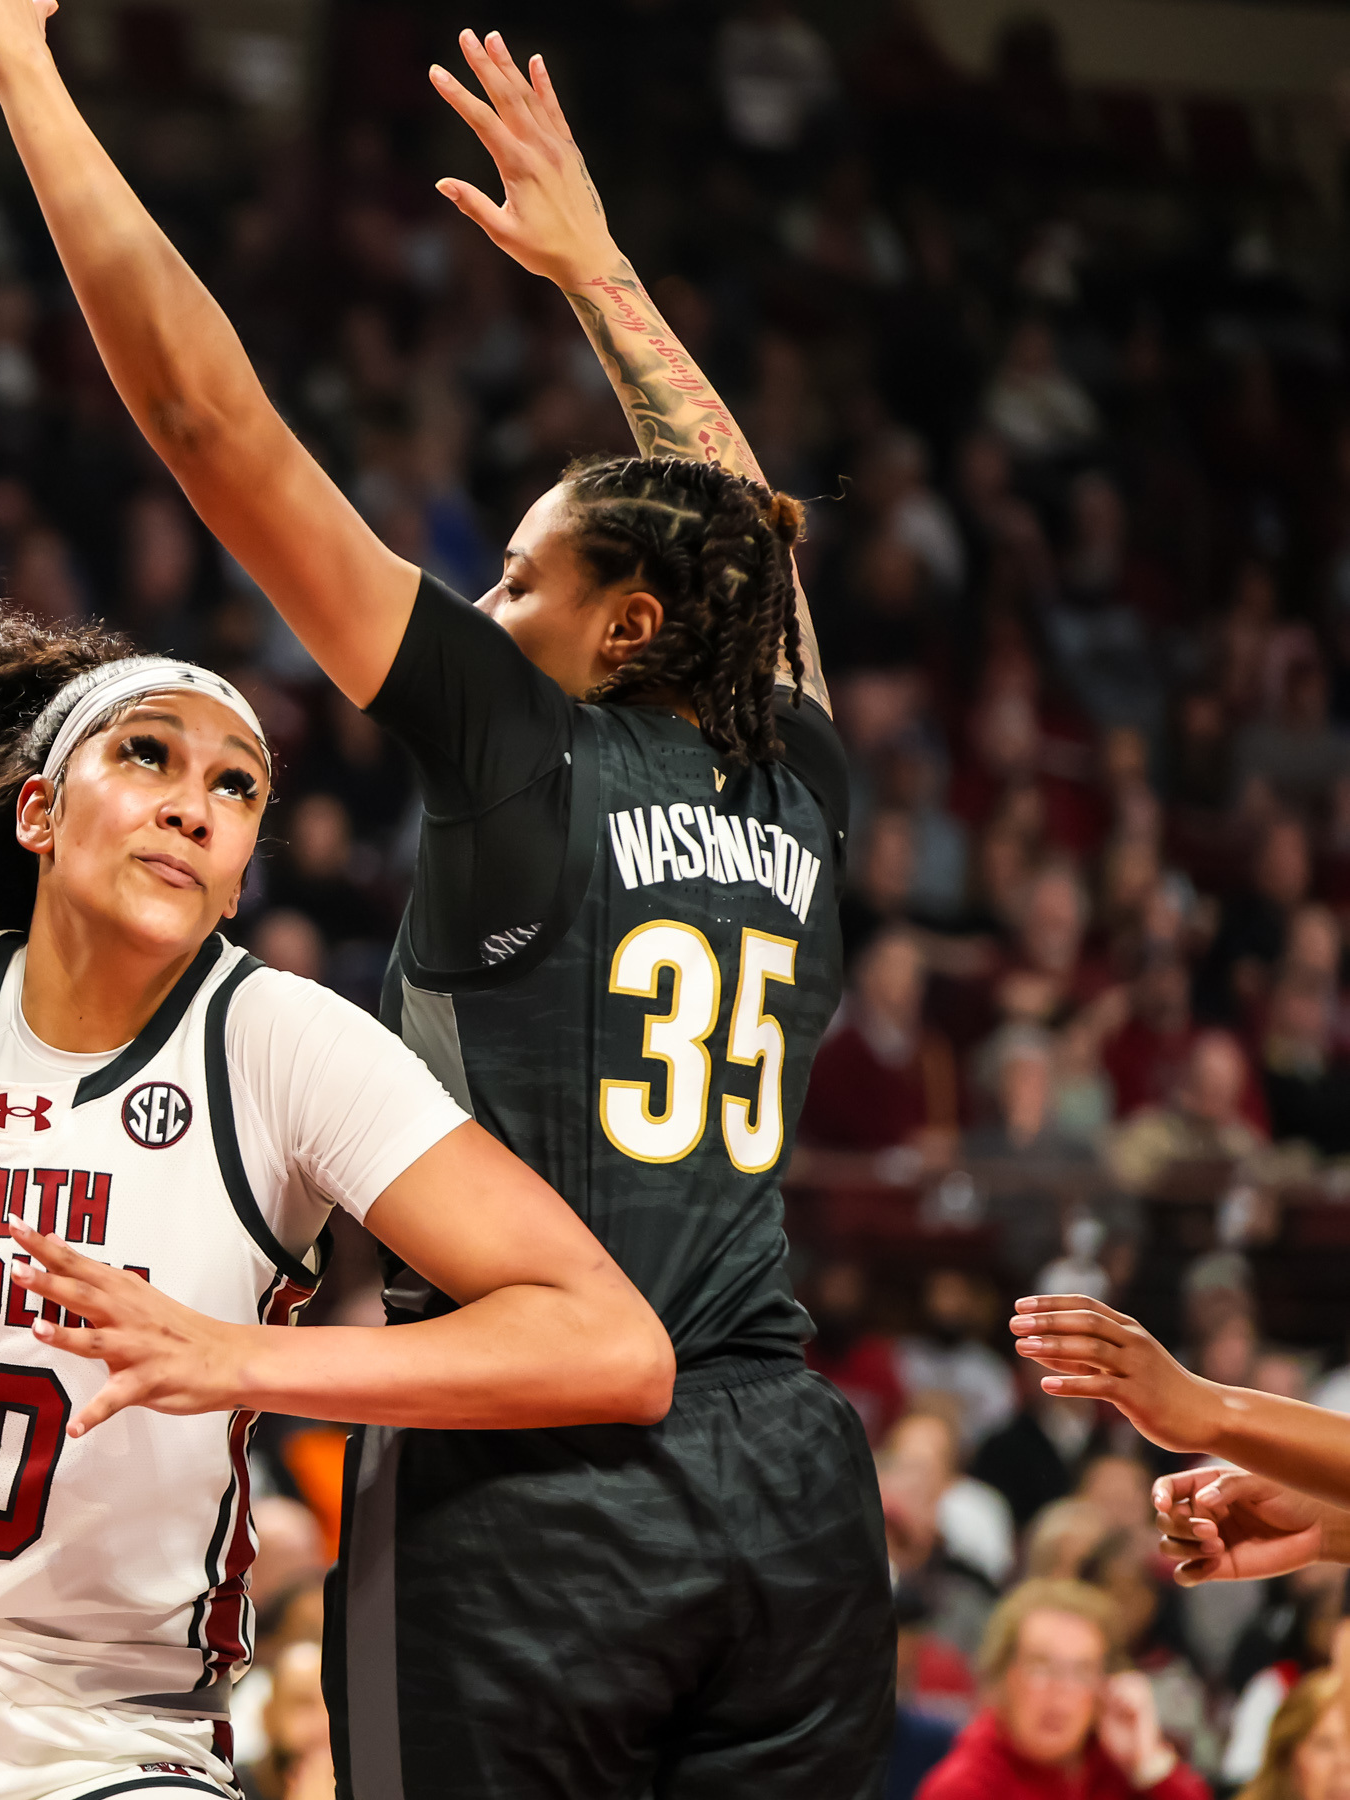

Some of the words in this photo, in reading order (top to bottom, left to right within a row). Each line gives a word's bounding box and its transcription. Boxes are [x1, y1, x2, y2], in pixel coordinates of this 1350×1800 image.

[577, 276, 648, 332] through
[648, 338, 704, 392] things
[685, 396, 730, 420] all
[703, 421, 733, 437] do
[599, 919, 799, 1174] 35
[129, 1086, 186, 1143] SEC
